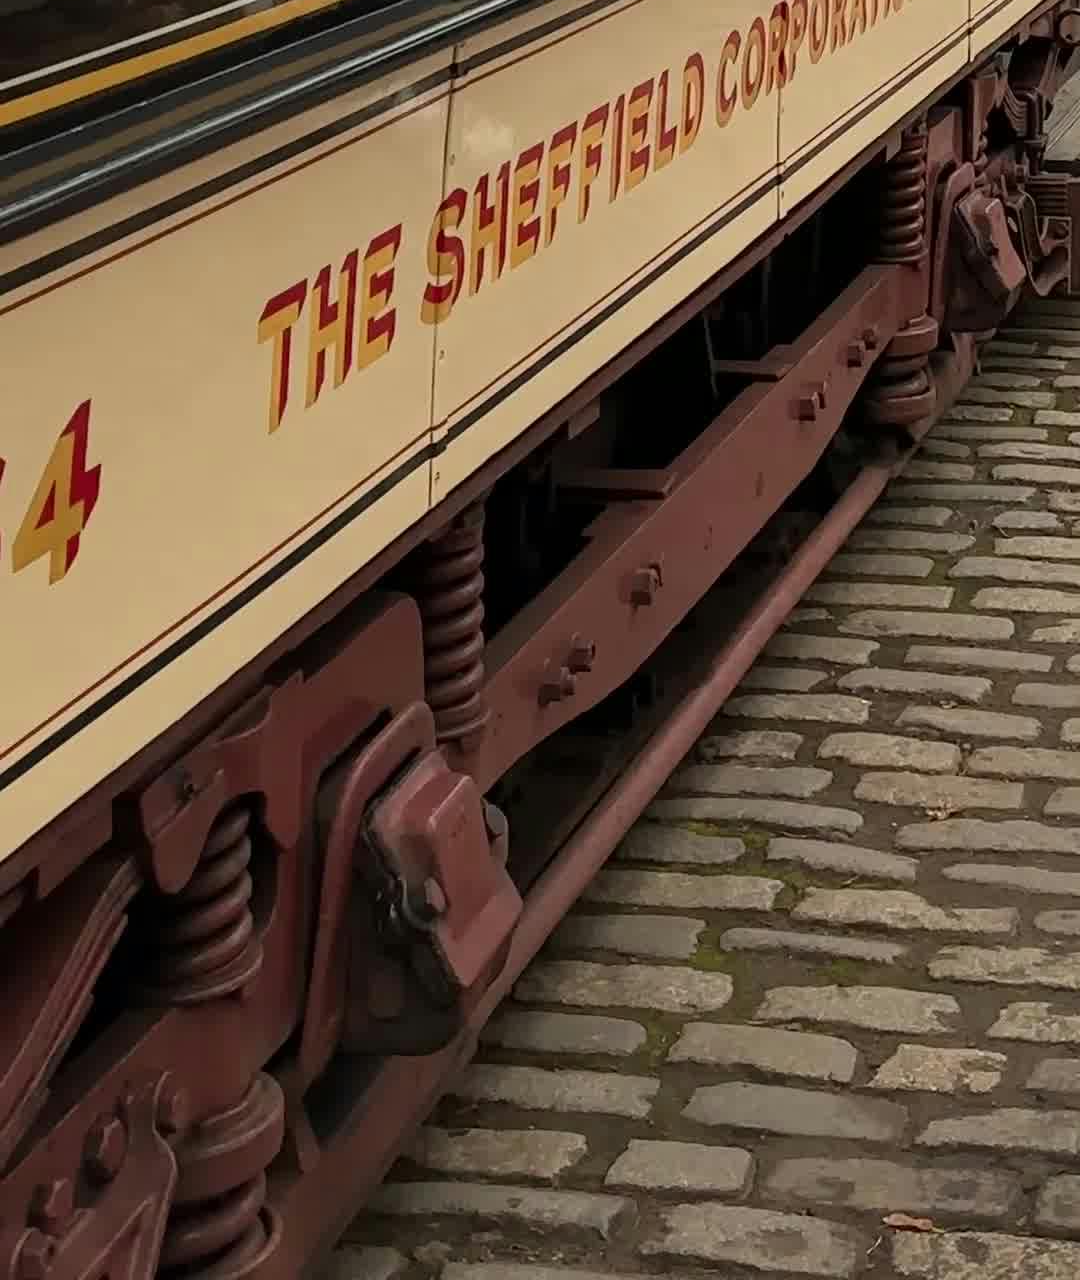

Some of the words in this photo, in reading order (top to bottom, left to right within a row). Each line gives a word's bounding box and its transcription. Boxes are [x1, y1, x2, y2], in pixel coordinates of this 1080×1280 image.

[257, 223, 402, 435] THE
[420, 52, 705, 326] SHEFFIELD
[0, 397, 102, 586] 4
